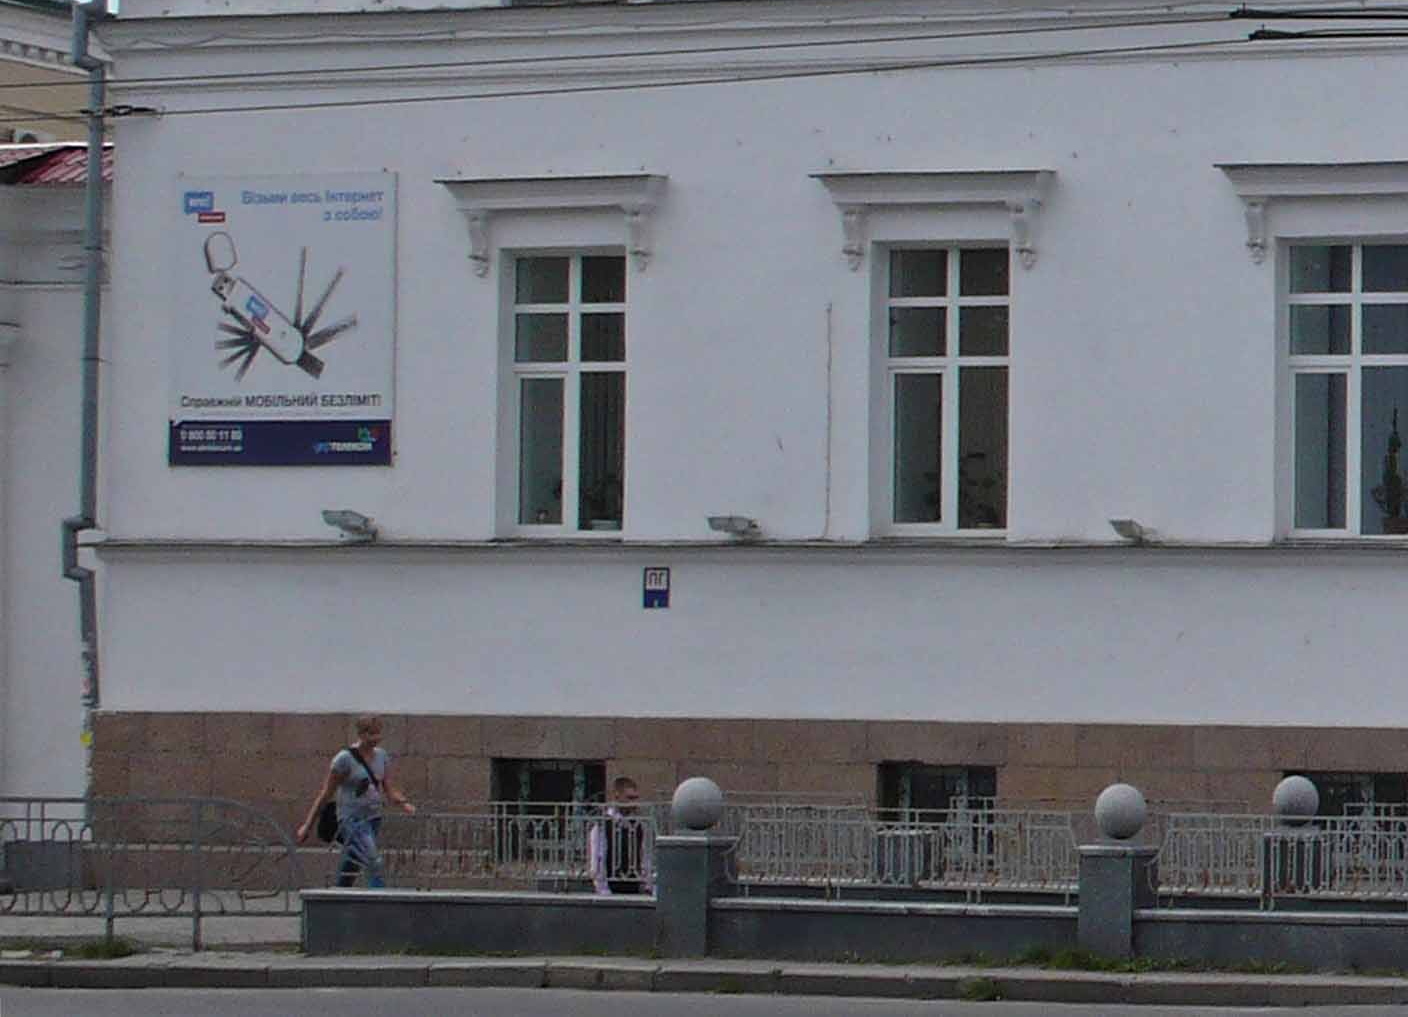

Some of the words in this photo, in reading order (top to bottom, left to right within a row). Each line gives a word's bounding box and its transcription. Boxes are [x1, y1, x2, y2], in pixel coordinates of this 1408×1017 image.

[290, 191, 321, 204] весь
[324, 189, 384, 204] Інтернет
[245, 391, 319, 408] МОБІЛЬНИЙ
